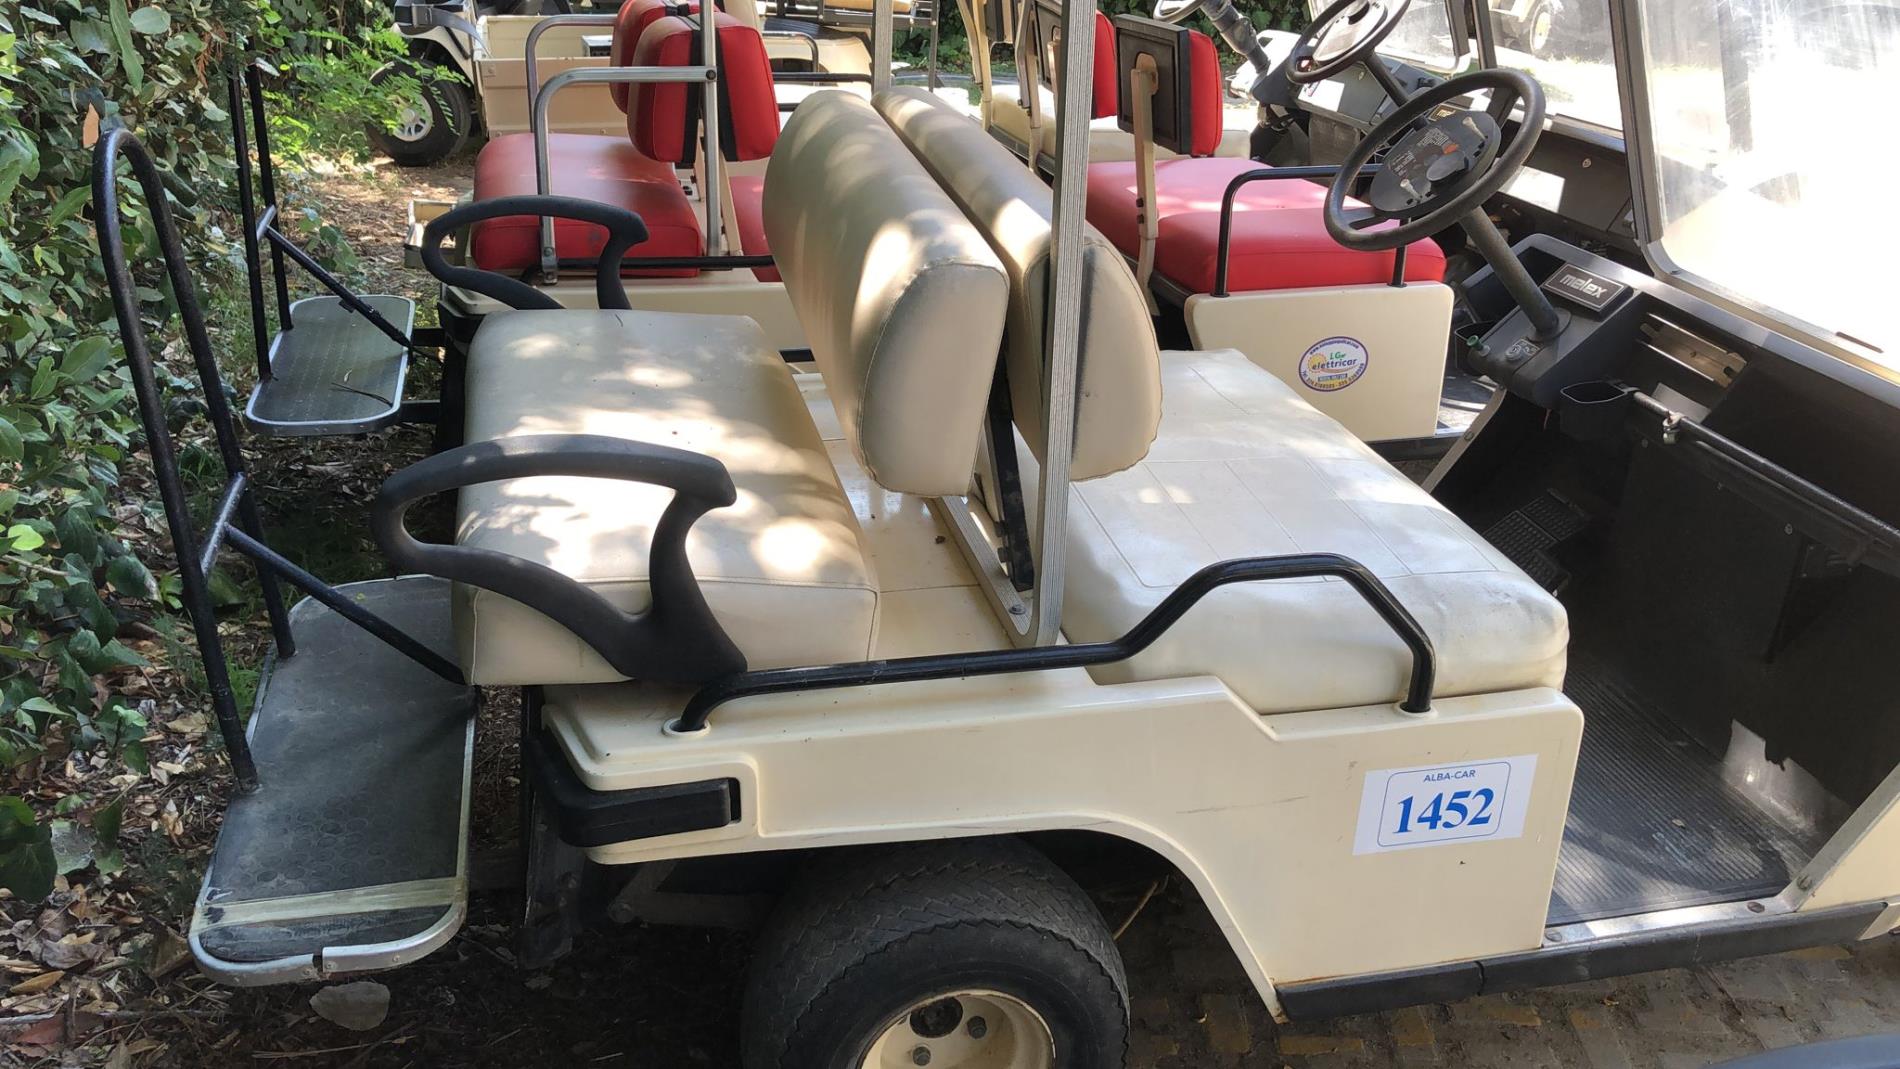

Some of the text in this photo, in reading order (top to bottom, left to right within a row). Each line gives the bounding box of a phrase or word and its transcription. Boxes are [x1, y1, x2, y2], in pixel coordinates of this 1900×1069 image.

[1560, 274, 1607, 298] melex
[1312, 359, 1358, 370] elettricar
[1423, 769, 1476, 782] ALBA-CAR
[1392, 788, 1494, 834] 1452
